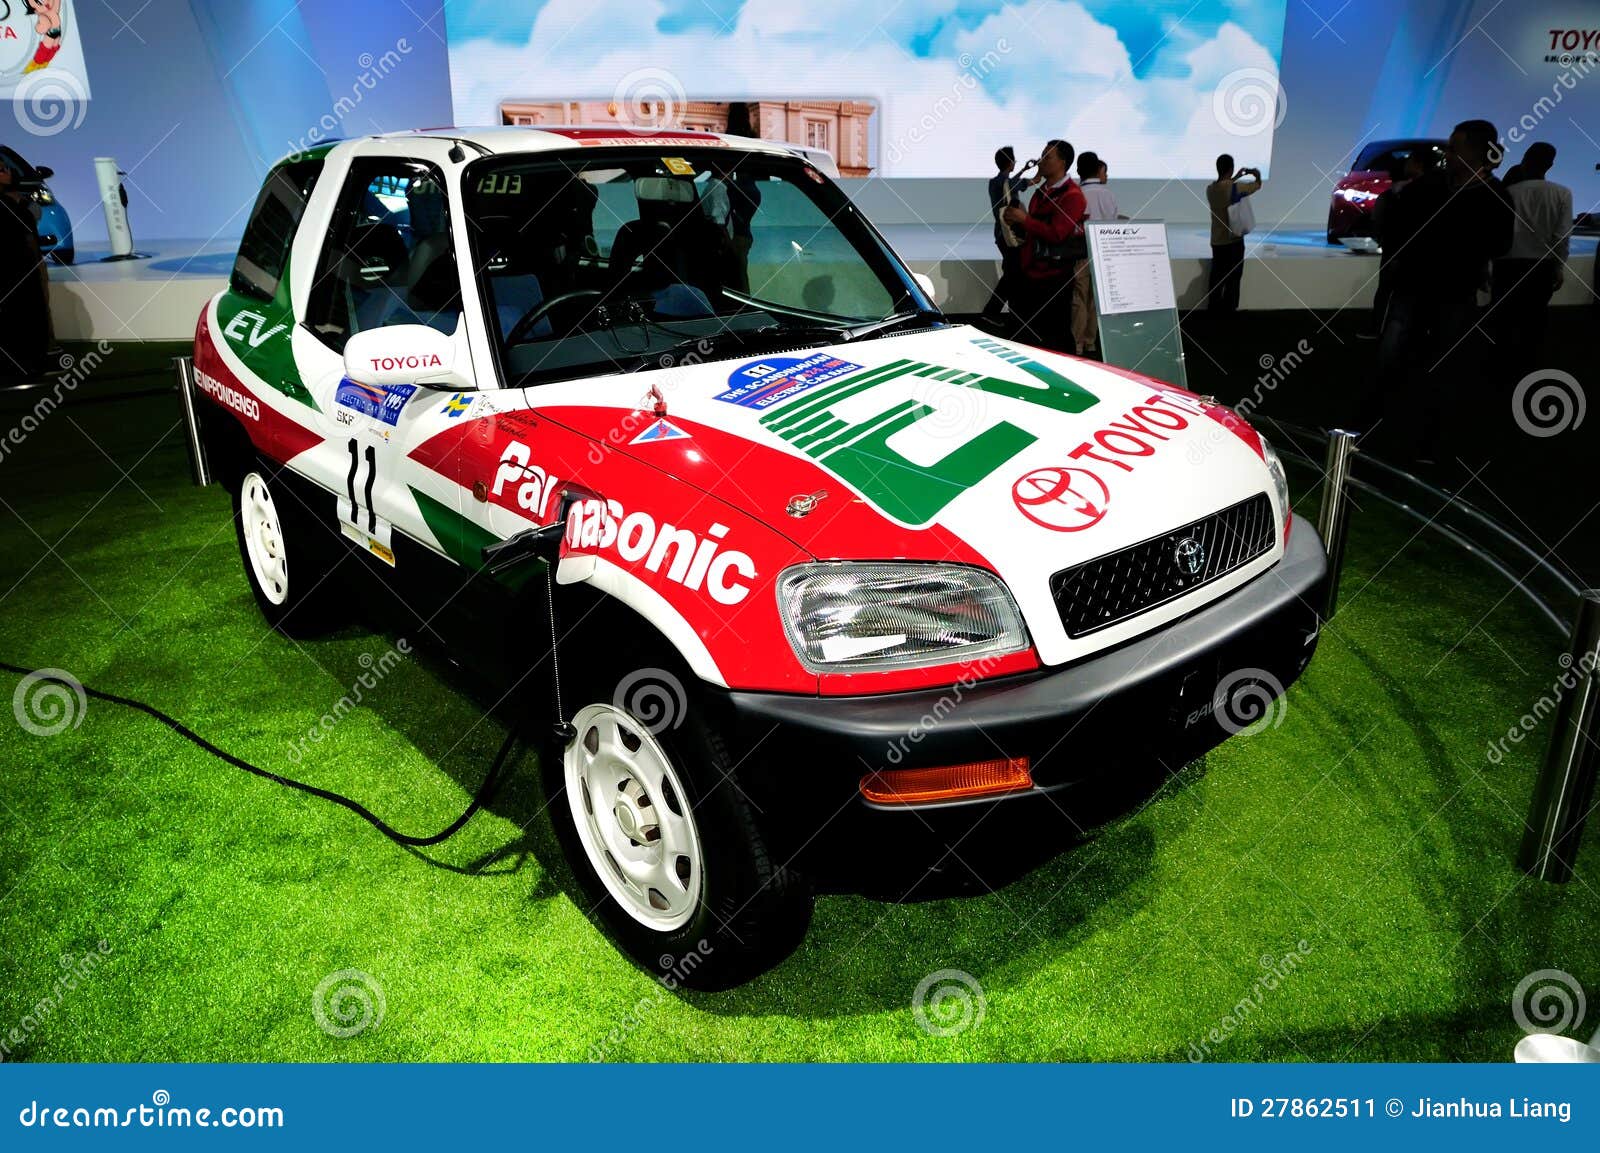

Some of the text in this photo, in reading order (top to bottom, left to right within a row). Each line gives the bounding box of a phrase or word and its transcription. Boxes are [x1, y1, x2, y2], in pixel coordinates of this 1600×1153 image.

[224, 310, 288, 347] EV
[370, 353, 442, 371] TOYOTA
[749, 364, 772, 378] 11
[721, 387, 747, 400] THE
[745, 354, 832, 390] SCANDINAVIAN
[383, 392, 406, 410] 1995
[756, 382, 808, 407] ELECTRIC
[347, 437, 377, 536] 11
